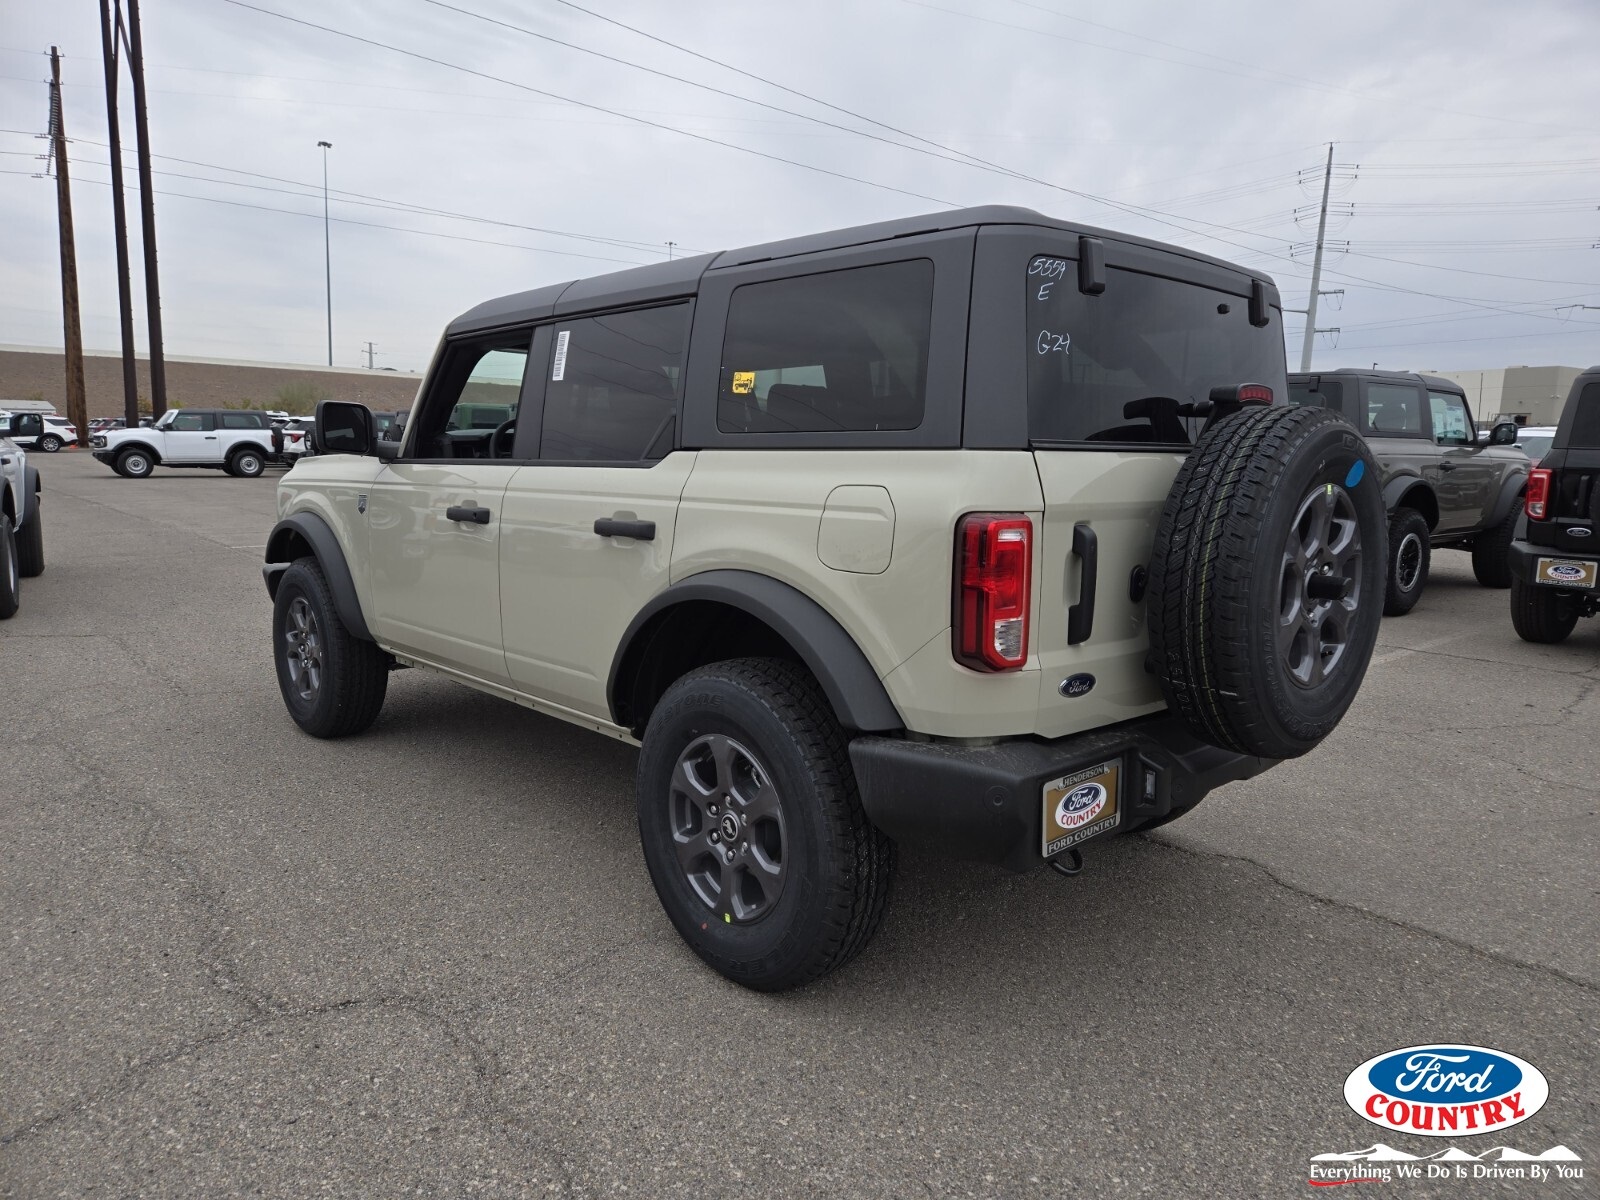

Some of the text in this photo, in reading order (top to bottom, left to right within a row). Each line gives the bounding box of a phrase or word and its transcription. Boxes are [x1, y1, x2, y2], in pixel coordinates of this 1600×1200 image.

[1028, 258, 1066, 280] 5559
[1037, 282, 1054, 301] E
[1037, 330, 1070, 354] G24
[1551, 572, 1582, 580] COUNTRY
[1557, 566, 1576, 575] Ford
[1559, 580, 1592, 588] COUNTRY
[1064, 766, 1104, 786] HENDERSON
[1068, 788, 1095, 811] Ford
[1061, 801, 1101, 826] COUNTRY
[1048, 817, 1116, 853] FORD COUNTRY
